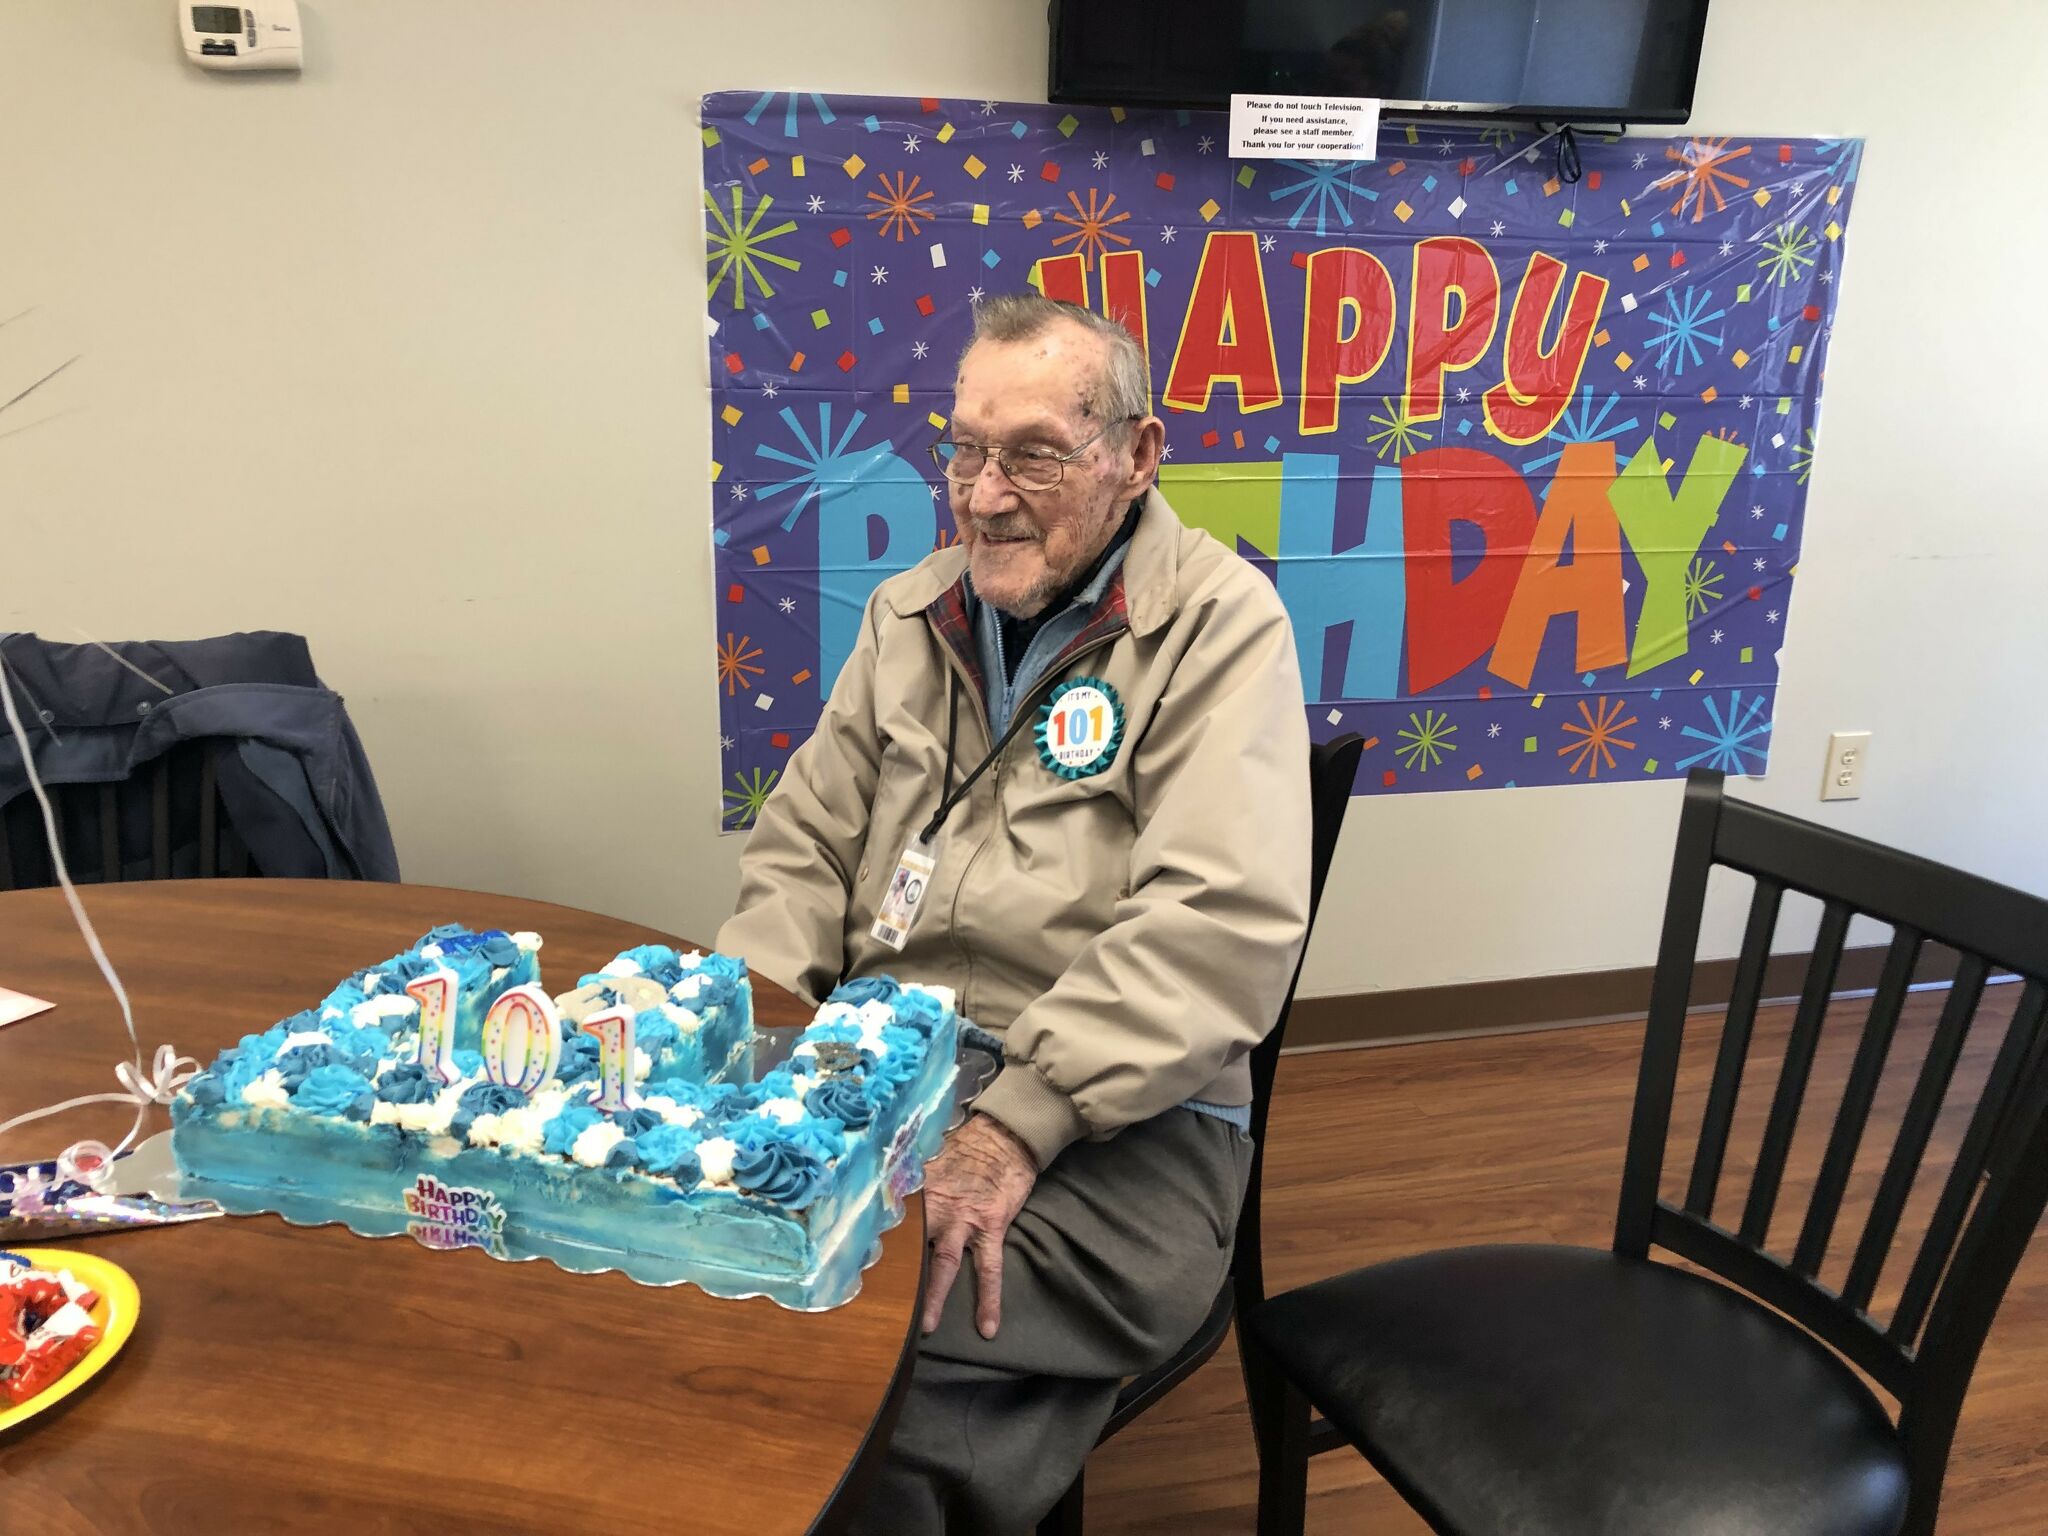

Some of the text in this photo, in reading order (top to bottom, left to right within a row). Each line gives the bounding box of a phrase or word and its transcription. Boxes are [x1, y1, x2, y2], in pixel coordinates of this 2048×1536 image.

[1246, 101, 1272, 110] Please
[1274, 102, 1284, 110] do
[1286, 102, 1298, 110] not
[1301, 103, 1322, 111] touch
[1262, 115, 1348, 126] If you need assistance,
[1253, 127, 1279, 136] please
[1302, 128, 1320, 136] staff
[1242, 141, 1266, 149] Thank
[1268, 142, 1282, 150] you
[1284, 141, 1296, 149] for
[1297, 143, 1315, 151] your
[1082, 691, 1092, 699] MY
[1053, 705, 1104, 746] 101
[1059, 749, 1093, 760] BIRTHDAY
[405, 969, 637, 1113] 101
[416, 1178, 491, 1210] HAPPY
[405, 1193, 503, 1230] BIRTHDAY
